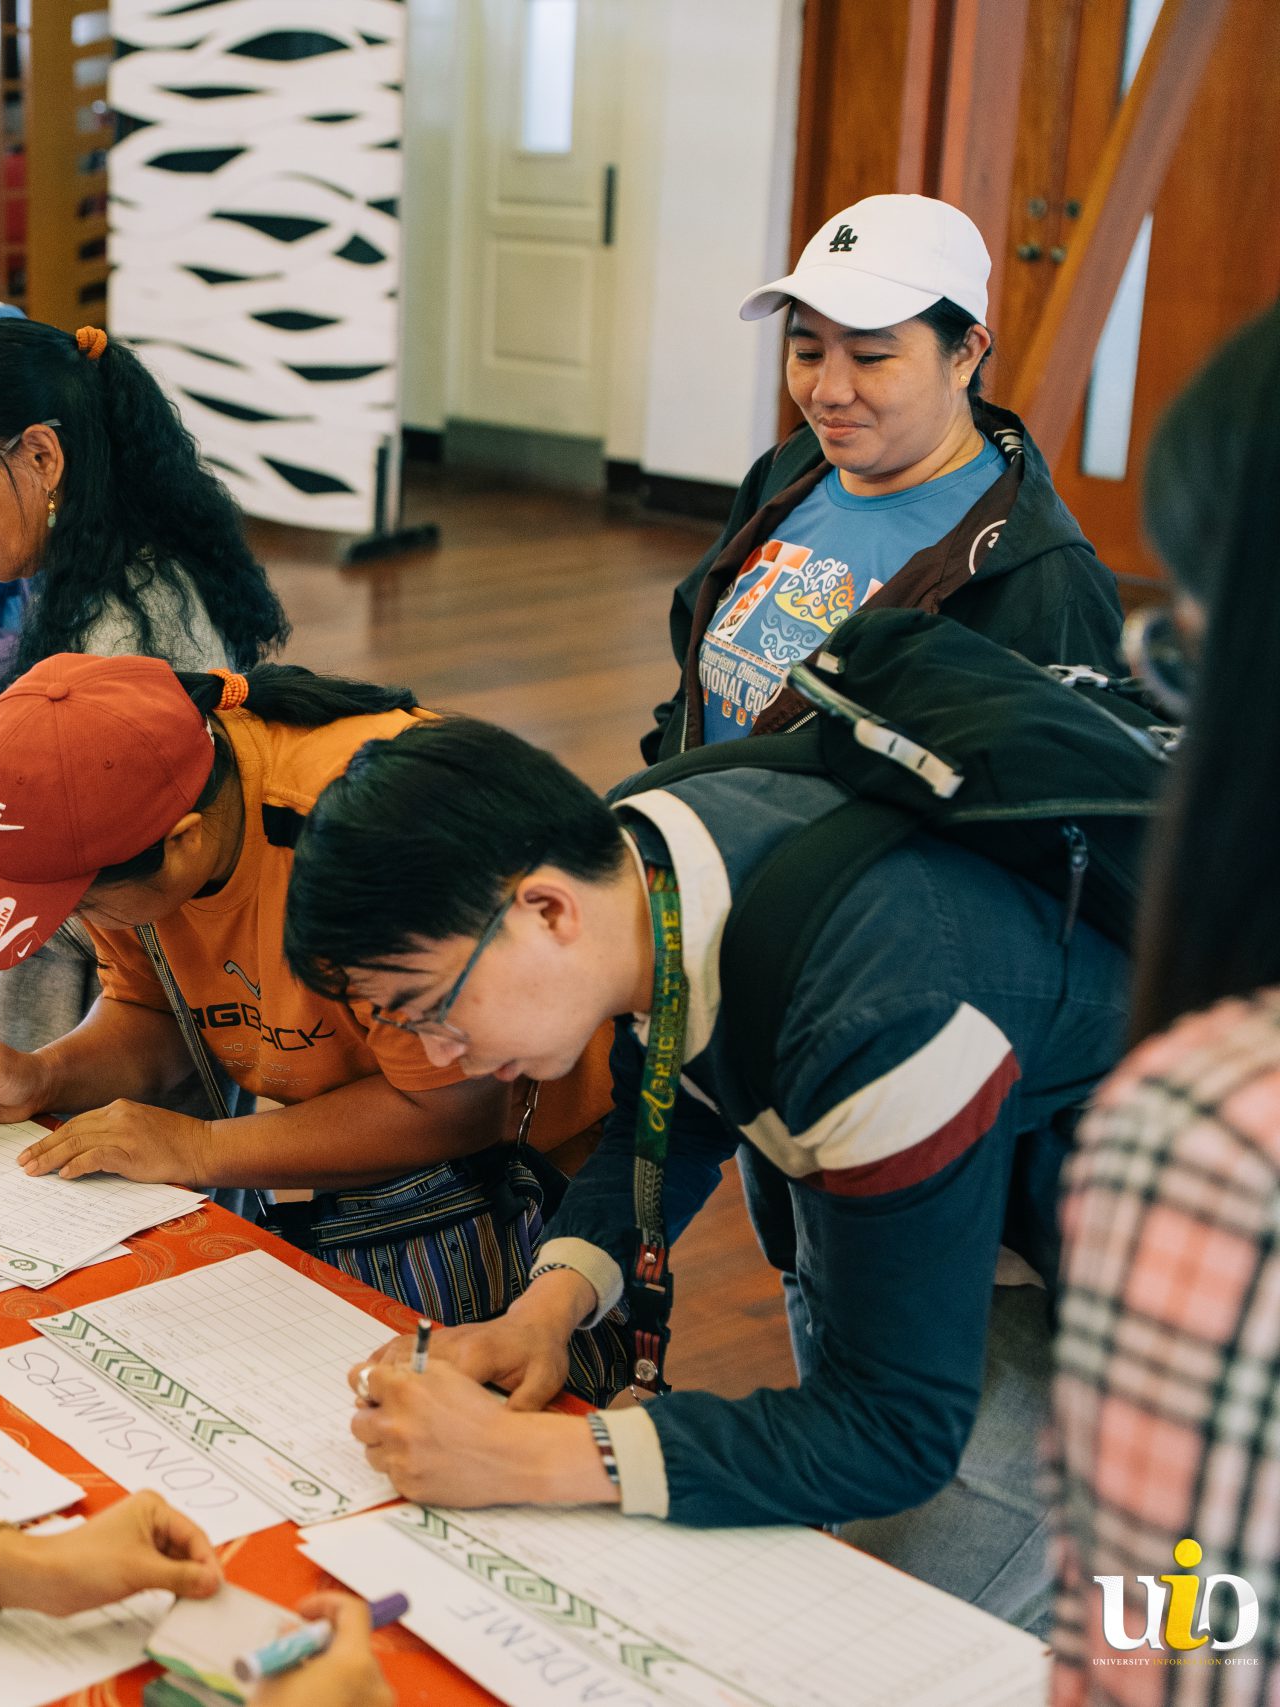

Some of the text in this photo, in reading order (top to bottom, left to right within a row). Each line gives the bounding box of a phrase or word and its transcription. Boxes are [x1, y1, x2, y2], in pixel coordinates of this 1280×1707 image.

[829, 224, 858, 253] LA
[736, 661, 770, 692] Officers
[7, 1351, 239, 1510] CONSUMERS
[446, 1597, 628, 1703] ADEME
